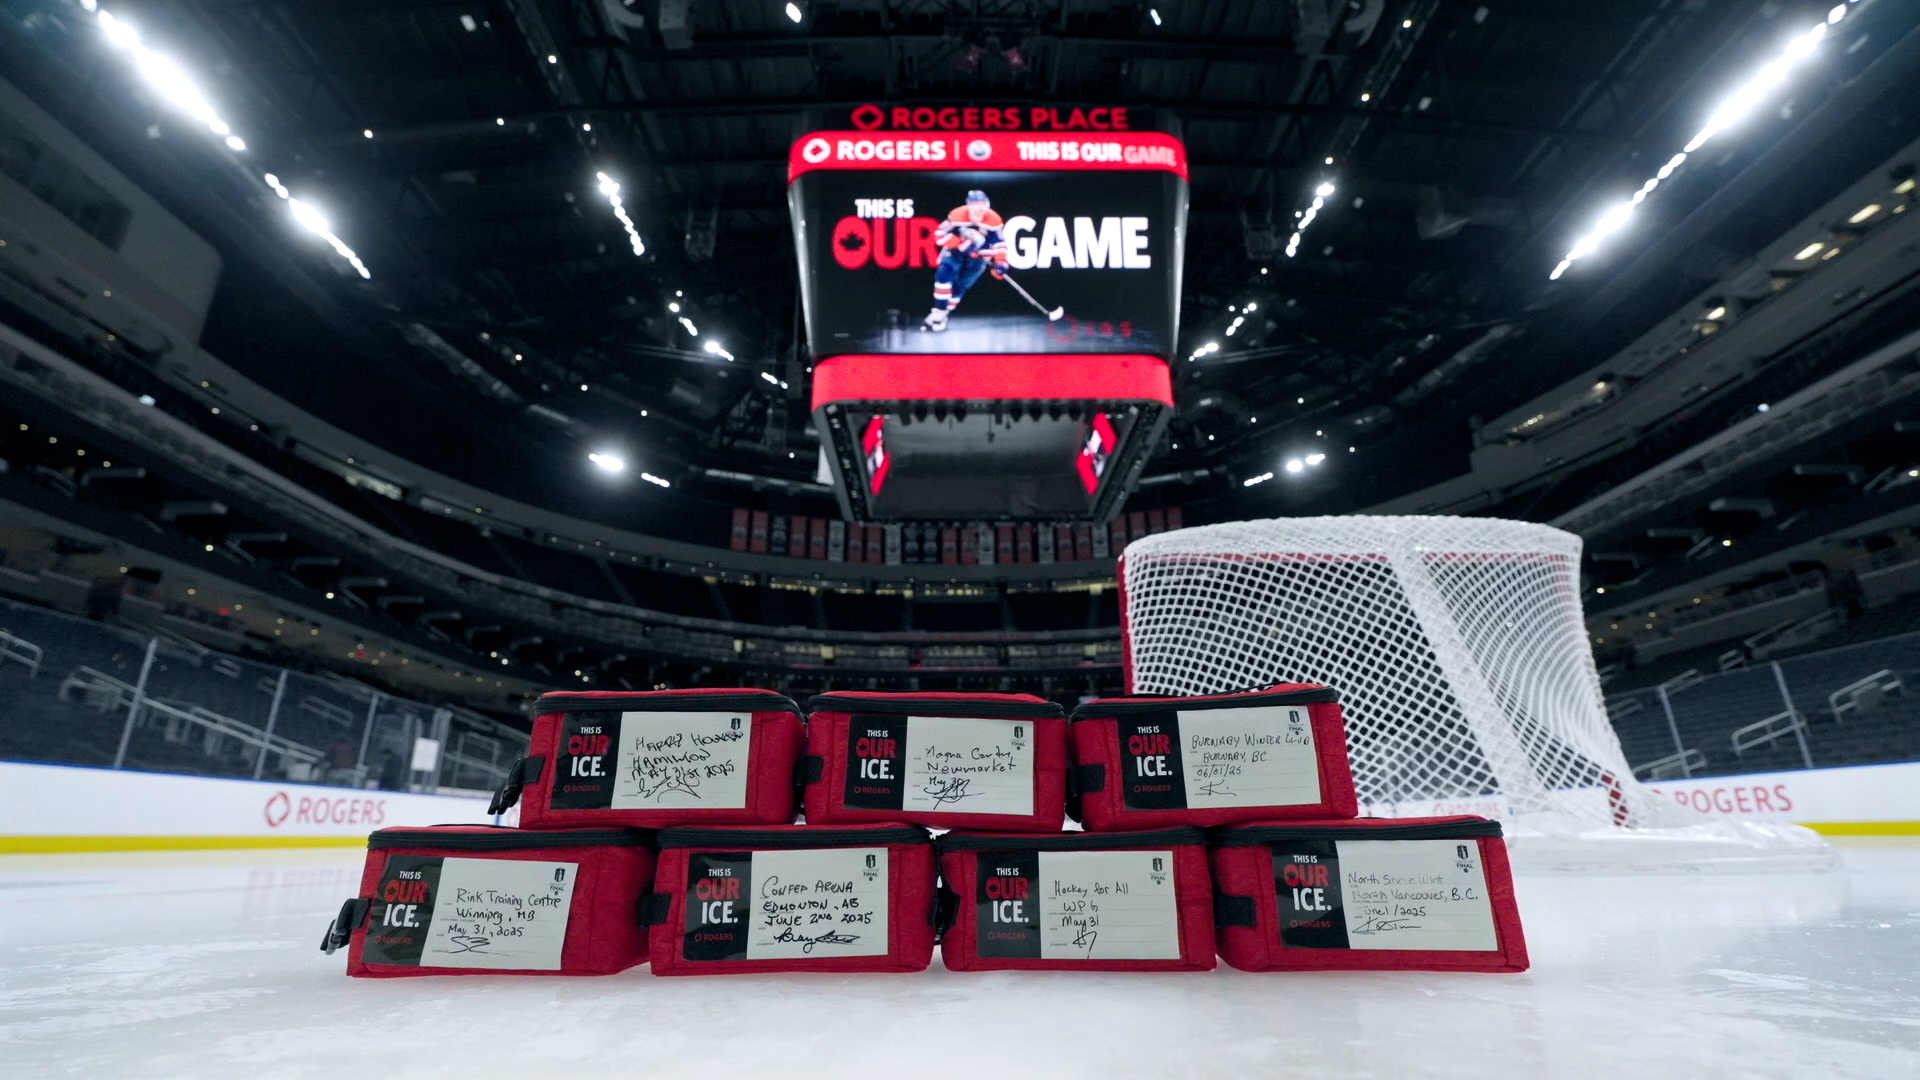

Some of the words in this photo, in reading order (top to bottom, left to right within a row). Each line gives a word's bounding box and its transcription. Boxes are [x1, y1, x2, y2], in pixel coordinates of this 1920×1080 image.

[892, 107, 1021, 129] ROGERS
[1031, 107, 1129, 129] PLACE
[837, 141, 946, 161] ROGERS
[1017, 142, 1059, 161] THIS
[1061, 142, 1080, 161] IS
[1081, 142, 1122, 162] OUR
[1124, 145, 1177, 167] GAME
[855, 199, 894, 218] THIS
[896, 199, 914, 218] IS
[832, 215, 942, 270] OUR
[1004, 215, 1151, 270] GAME
[580, 726, 594, 734] THIS
[595, 726, 601, 734] IS
[1137, 726, 1152, 734] THIS
[568, 735, 611, 755] OUR
[856, 737, 896, 759] OUR
[1129, 734, 1171, 755] OUR
[1192, 735, 1240, 749] BURNABY
[1245, 733, 1281, 746] WINTER
[927, 756, 1016, 774] Newmarket
[1136, 755, 1173, 777] ICE.
[1252, 751, 1267, 762] BC
[571, 756, 606, 777] ICE.
[704, 760, 734, 778] 2025
[860, 759, 894, 779] ICE.
[1197, 764, 1241, 778] 06/01/25
[296, 797, 388, 824] ROGERS
[1293, 855, 1309, 863] THIS
[1310, 855, 1317, 863] IS
[399, 871, 414, 879] THIS
[415, 871, 422, 879] IS
[708, 869, 723, 877] THIS
[996, 868, 1011, 876] THIS
[1284, 864, 1330, 887] OUR
[1348, 872, 1379, 884] North
[384, 879, 429, 903] OUR
[696, 878, 740, 900] OUR
[986, 877, 1030, 899] OUR
[1055, 880, 1087, 897] Hockey
[1094, 882, 1110, 894] for
[1116, 881, 1128, 894] All
[1352, 889, 1387, 900] North
[456, 888, 483, 903] Rink
[486, 890, 523, 910] Training
[528, 894, 561, 908] Centre
[842, 898, 859, 908] AB
[1293, 888, 1332, 911] ICE.
[383, 904, 420, 928] ICE.
[518, 910, 535, 921] MB
[701, 901, 739, 924] ICE.
[765, 914, 801, 926] JUNE
[841, 911, 873, 924] 2025
[993, 900, 1029, 923] ICE.
[448, 923, 467, 936] May
[497, 926, 524, 937] 2025
[1062, 916, 1087, 931] May
[1090, 914, 1099, 927] 31
[704, 933, 734, 941] ROGERS
